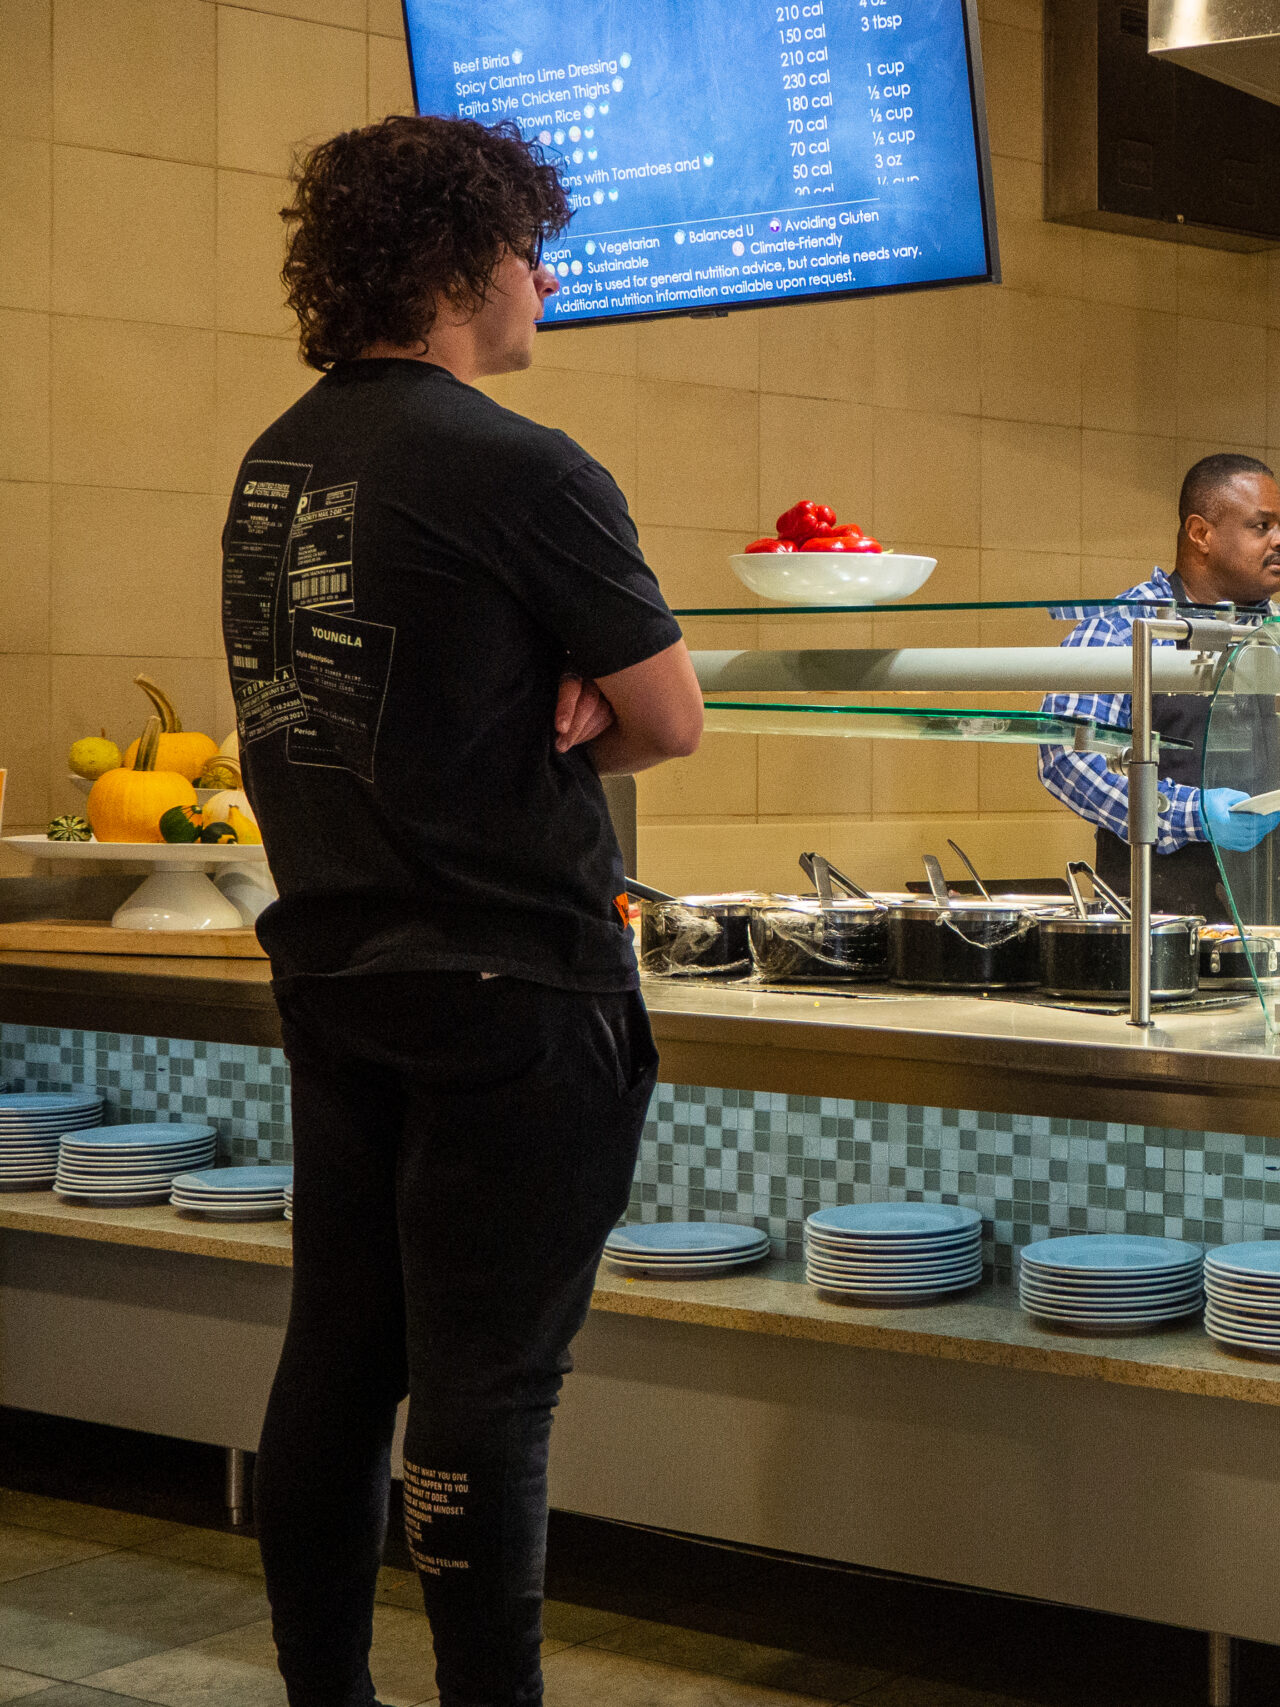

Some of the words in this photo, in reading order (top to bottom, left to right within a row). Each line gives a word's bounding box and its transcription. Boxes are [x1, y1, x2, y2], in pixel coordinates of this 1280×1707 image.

[775, 5, 799, 22] 210
[802, 0, 824, 17] cal
[861, 17, 870, 31] 3
[872, 14, 902, 30] tbsp
[779, 27, 801, 44] 150
[804, 23, 826, 40] cal
[453, 56, 480, 74] Beef
[482, 54, 510, 70] Birria
[780, 50, 804, 67] 210
[806, 46, 828, 63] cal
[455, 80, 487, 98] Spicy
[489, 73, 535, 91] Cilantro
[537, 68, 565, 83] Lime
[568, 59, 618, 78] Dressing
[783, 73, 806, 90] 230
[809, 68, 831, 86] cal
[866, 63, 873, 77] 1
[877, 61, 905, 77] cup
[458, 100, 490, 118] Fajita
[491, 96, 519, 113] Style
[521, 88, 571, 107] Chicken
[572, 81, 610, 100] Thighs
[883, 83, 911, 99] cup
[786, 95, 809, 112] 180
[811, 91, 833, 108] cal
[555, 109, 582, 124] Rice
[885, 106, 913, 122] cup
[787, 119, 804, 135] 70
[806, 115, 828, 132] cal
[888, 129, 916, 145] cup
[789, 141, 806, 157] 70
[808, 138, 830, 154] cal
[584, 169, 610, 185] with
[611, 162, 672, 181] Tomatoes
[674, 156, 701, 173] and
[792, 164, 808, 180] 50
[811, 160, 833, 177] cal
[874, 154, 884, 168] 3
[886, 154, 903, 167] oz
[543, 248, 572, 263] egan
[598, 236, 661, 255] Vegetarian
[689, 224, 744, 244] Balanced
[745, 224, 754, 237] U
[785, 216, 837, 232] Avoiding
[839, 210, 879, 226] Gluten
[587, 256, 649, 274] Sustainable
[750, 233, 843, 255] Climate-Friendly
[561, 286, 570, 296] a
[572, 281, 593, 297] day
[595, 280, 603, 292] is
[605, 277, 631, 292] used
[633, 275, 648, 288] for
[650, 268, 693, 288] general
[695, 264, 739, 280] nutrition
[742, 261, 786, 276] advice,
[787, 256, 808, 271] but
[810, 252, 850, 268] calorie
[853, 246, 890, 263] needs
[892, 245, 922, 260] vary.
[554, 296, 609, 314] Additional
[611, 292, 653, 308] nutrition
[655, 285, 718, 303] information
[720, 279, 774, 296] available
[775, 275, 807, 291] upon
[808, 270, 856, 288] request.
[311, 625, 363, 648] YOUNGLA
[293, 727, 317, 736] Period:
[420, 1478, 443, 1491] HAPPEN
[444, 1483, 453, 1493] TO
[437, 1471, 451, 1480] YOU
